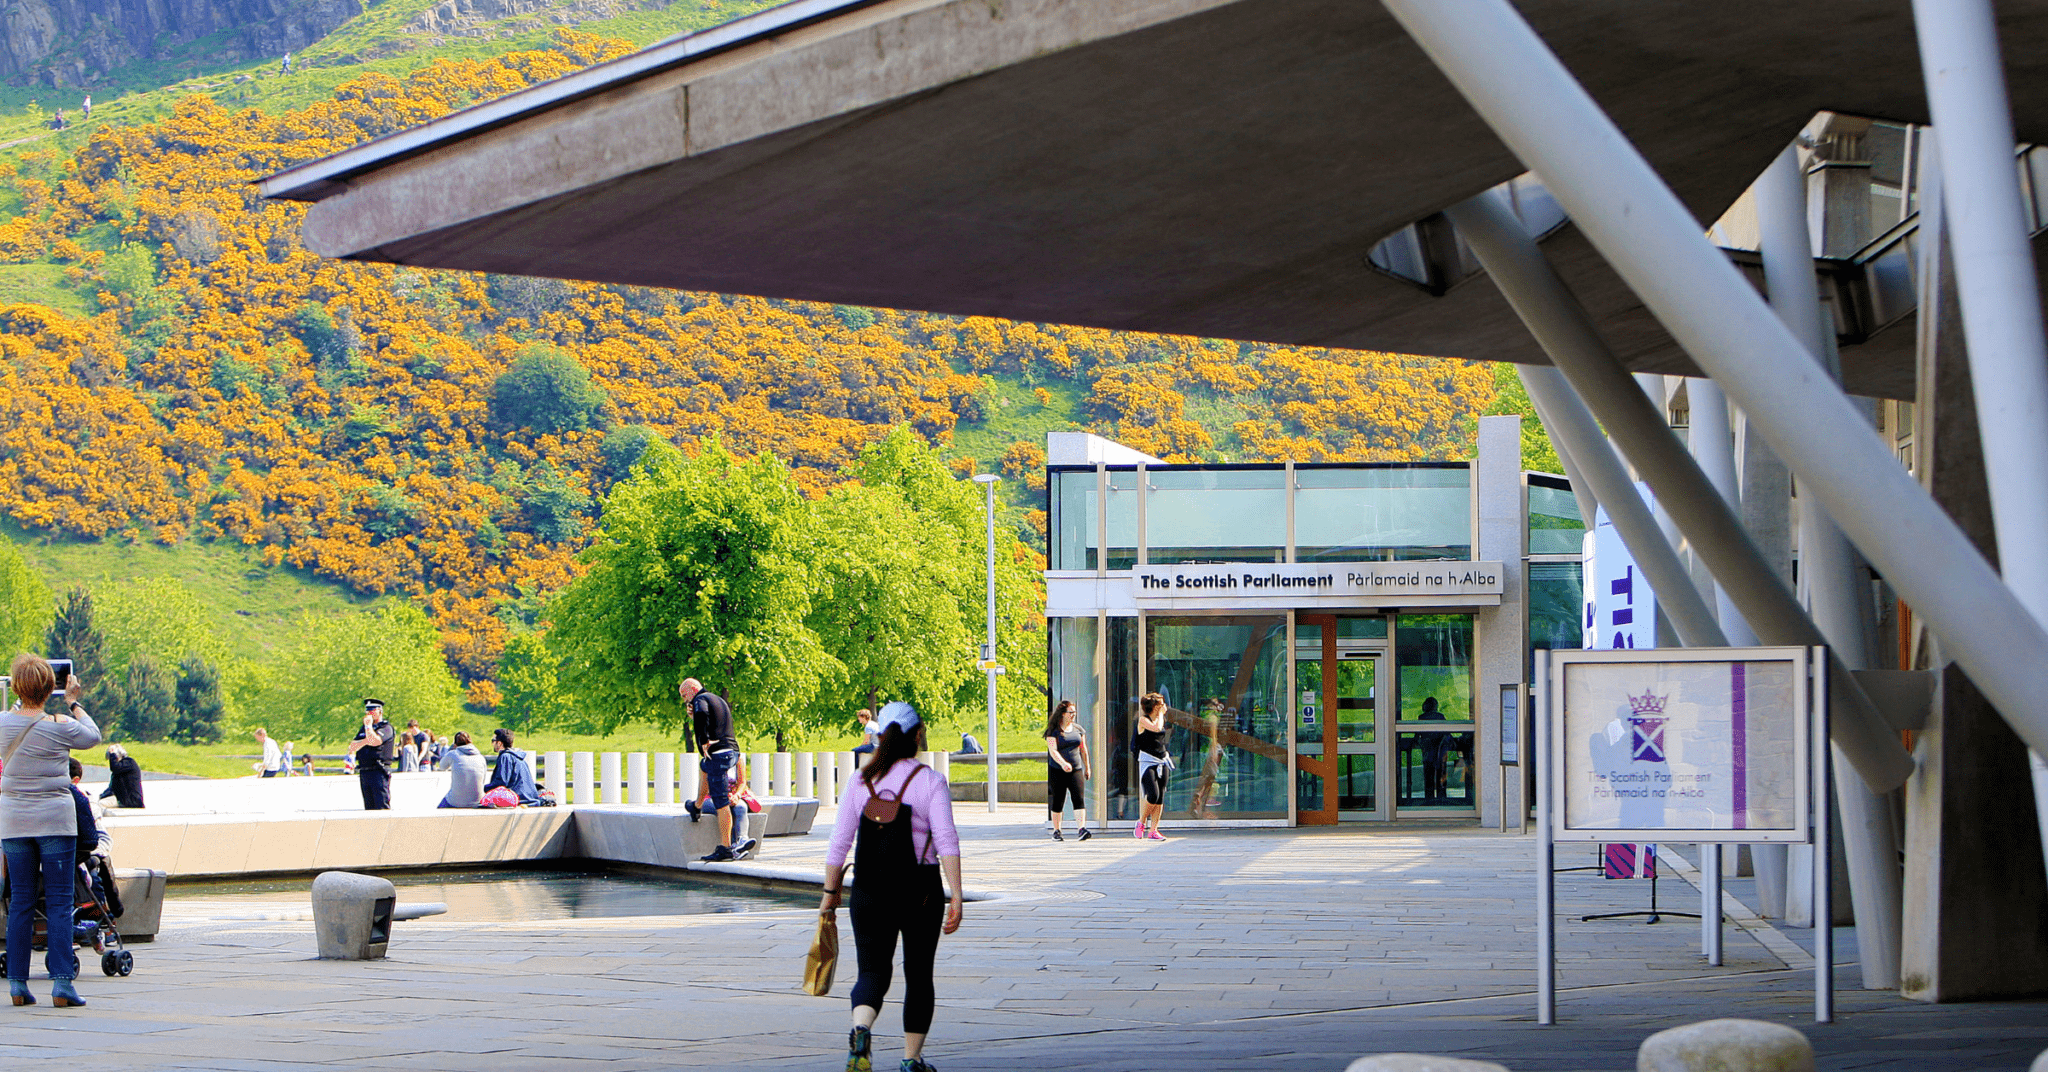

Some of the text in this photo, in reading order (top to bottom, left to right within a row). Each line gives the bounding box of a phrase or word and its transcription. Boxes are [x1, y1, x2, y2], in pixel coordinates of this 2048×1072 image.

[1141, 574, 1170, 588] The
[1175, 573, 1237, 588] Scottish
[1243, 572, 1333, 588] Parliament
[1347, 571, 1420, 586] Pàrlamaid
[1425, 574, 1443, 586] na
[1588, 769, 1711, 783] The Scottish Parliament
[1651, 788, 1666, 798] na
